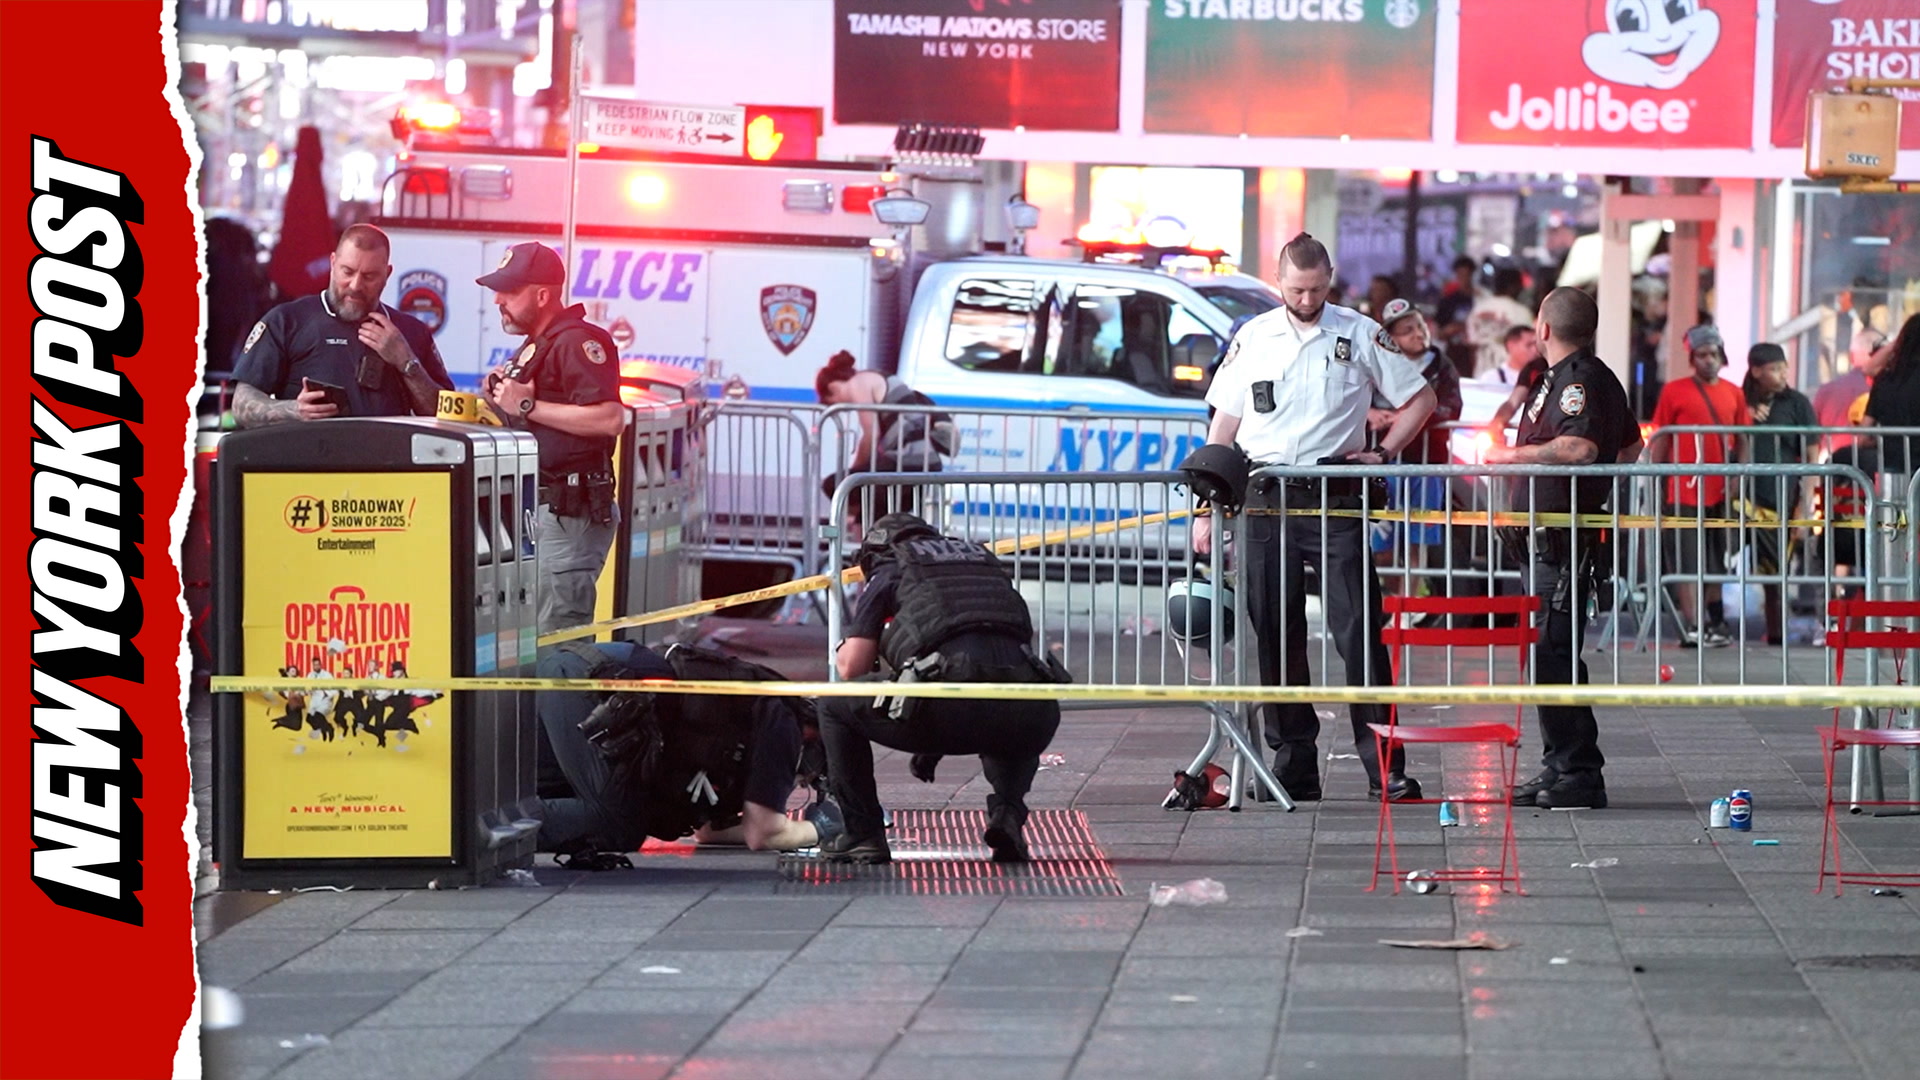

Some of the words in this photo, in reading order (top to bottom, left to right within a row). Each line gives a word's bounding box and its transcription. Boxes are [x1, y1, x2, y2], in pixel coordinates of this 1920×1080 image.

[1164, 0, 1365, 22] STARBUCKS
[1036, 19, 1107, 42] STORE
[923, 42, 968, 57] NEW
[975, 43, 1033, 59] YORK
[596, 103, 668, 121] PEDESTRIAN
[672, 109, 703, 123] FLOW
[707, 113, 737, 126] ZONE
[1489, 82, 1690, 133] Jollibee
[596, 122, 627, 135] KEEP
[630, 126, 674, 141] MOVING
[571, 249, 703, 302] LICE
[291, 500, 325, 528] #1
[331, 499, 405, 513] BROADWAY
[331, 515, 363, 527] SHOW
[365, 515, 378, 527] OF
[380, 515, 406, 527] 2025
[317, 537, 376, 550] Entertainment
[285, 602, 410, 645] OPERATION
[290, 805, 298, 813] A
[303, 805, 336, 813] NEW
[341, 805, 406, 813] MUSICAL
